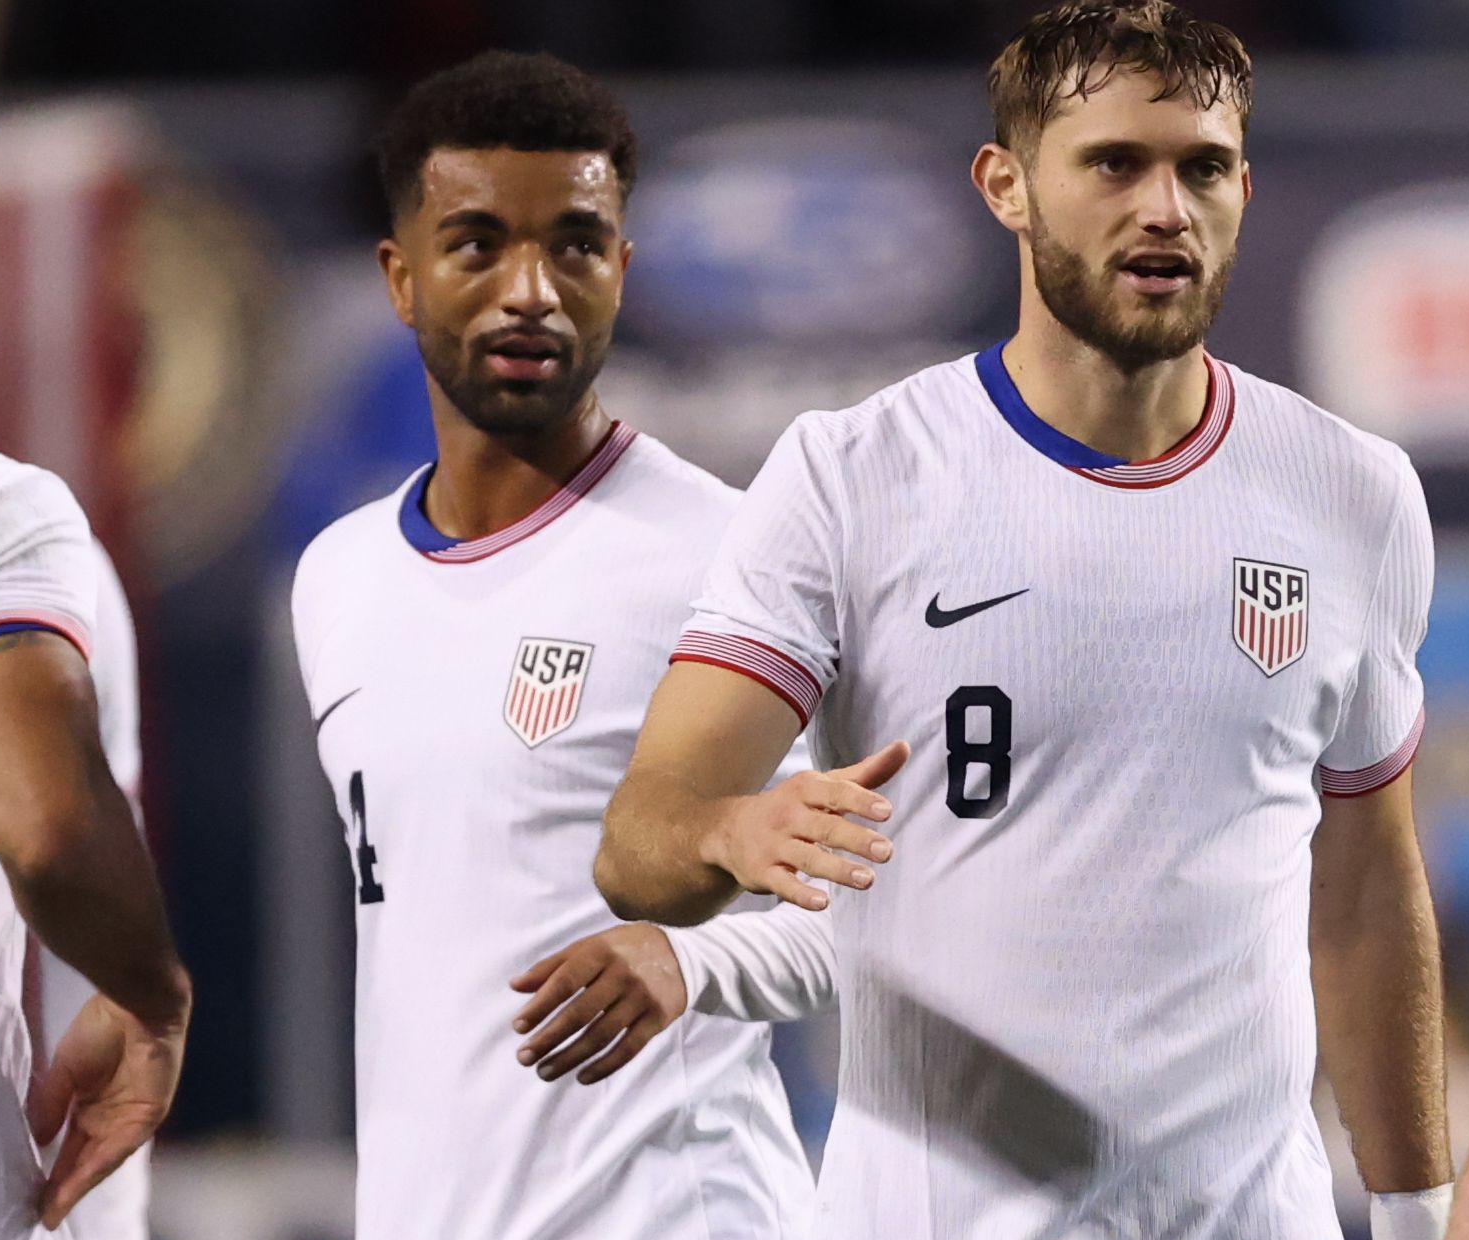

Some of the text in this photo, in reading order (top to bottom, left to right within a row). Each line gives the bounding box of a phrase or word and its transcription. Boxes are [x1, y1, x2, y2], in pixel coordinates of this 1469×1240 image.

[1239, 566, 1303, 611] USA
[521, 644, 585, 685] USA
[946, 685, 1012, 819] 8
